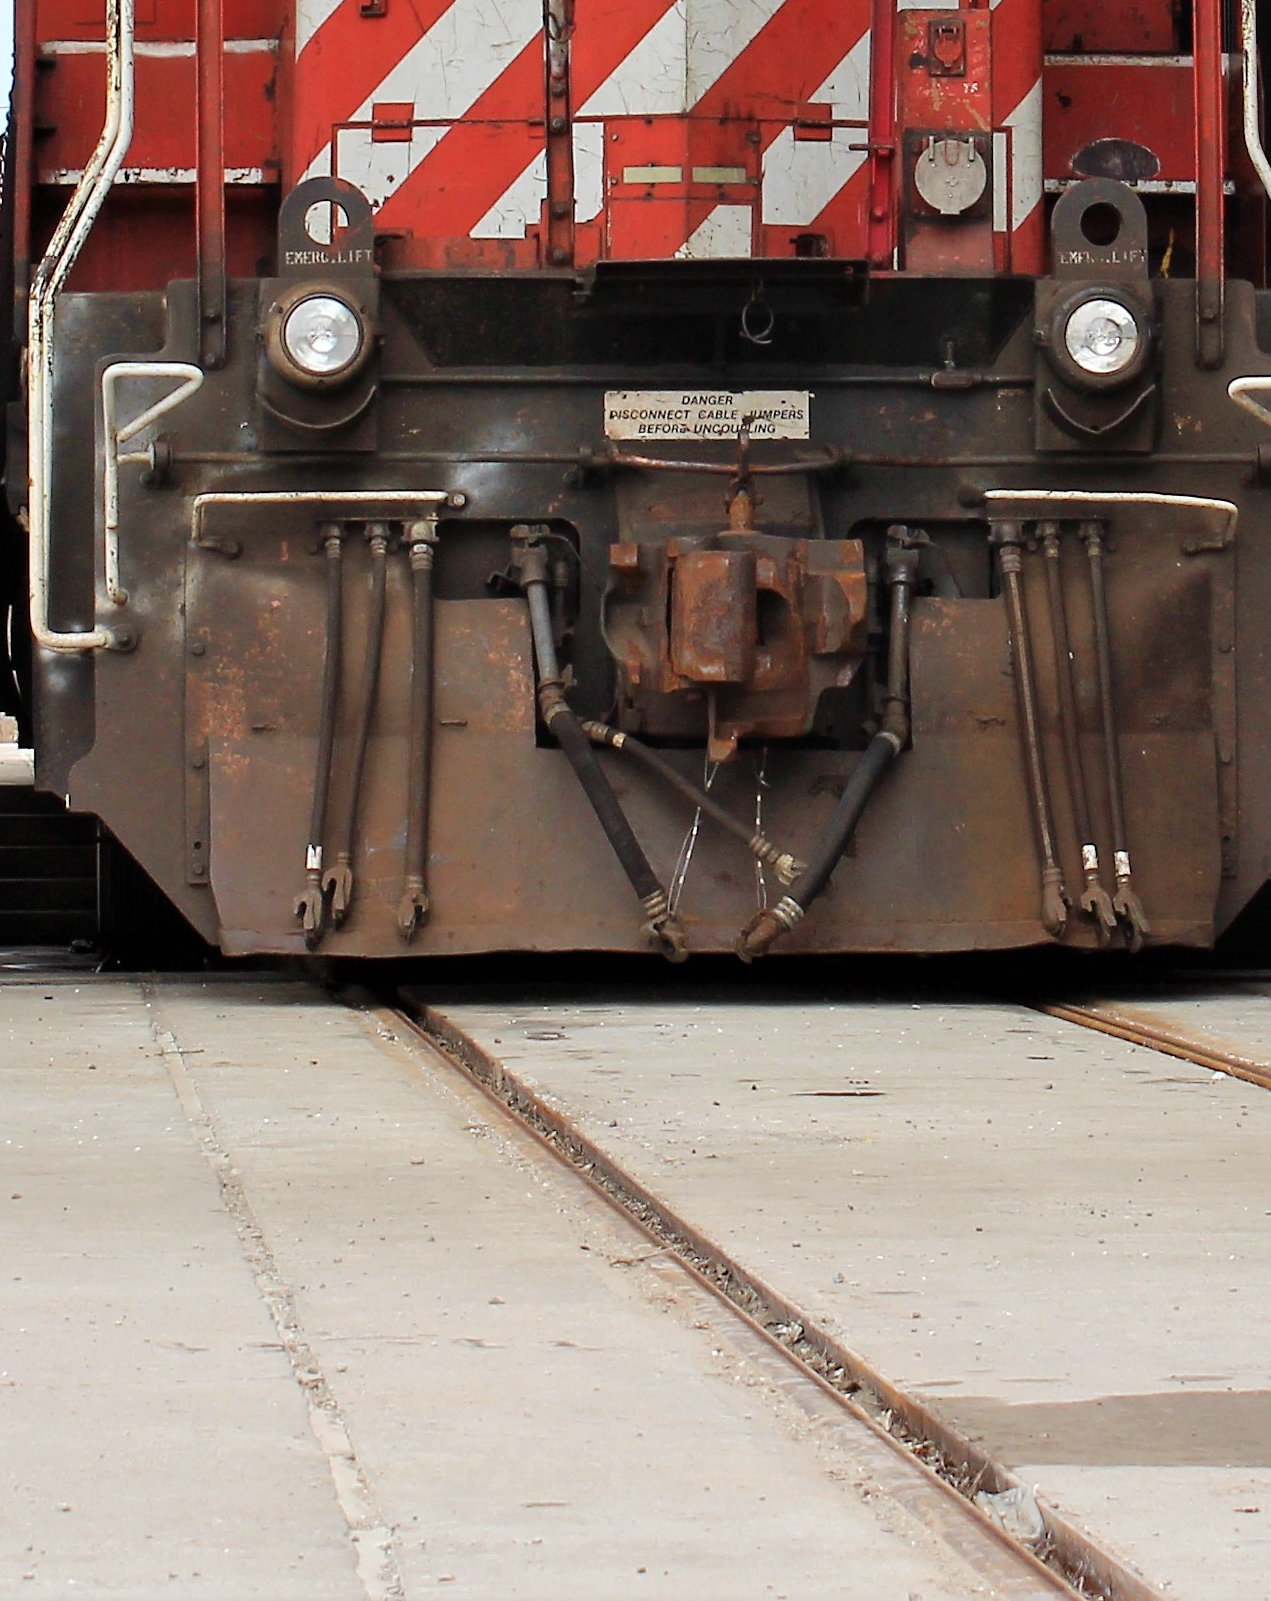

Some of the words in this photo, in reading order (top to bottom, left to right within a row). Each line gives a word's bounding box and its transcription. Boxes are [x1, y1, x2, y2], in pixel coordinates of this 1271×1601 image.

[681, 395, 733, 406] DANGER
[609, 409, 691, 420] DISCONNECT
[698, 409, 739, 420] CABLE
[638, 423, 687, 434] BEFORE
